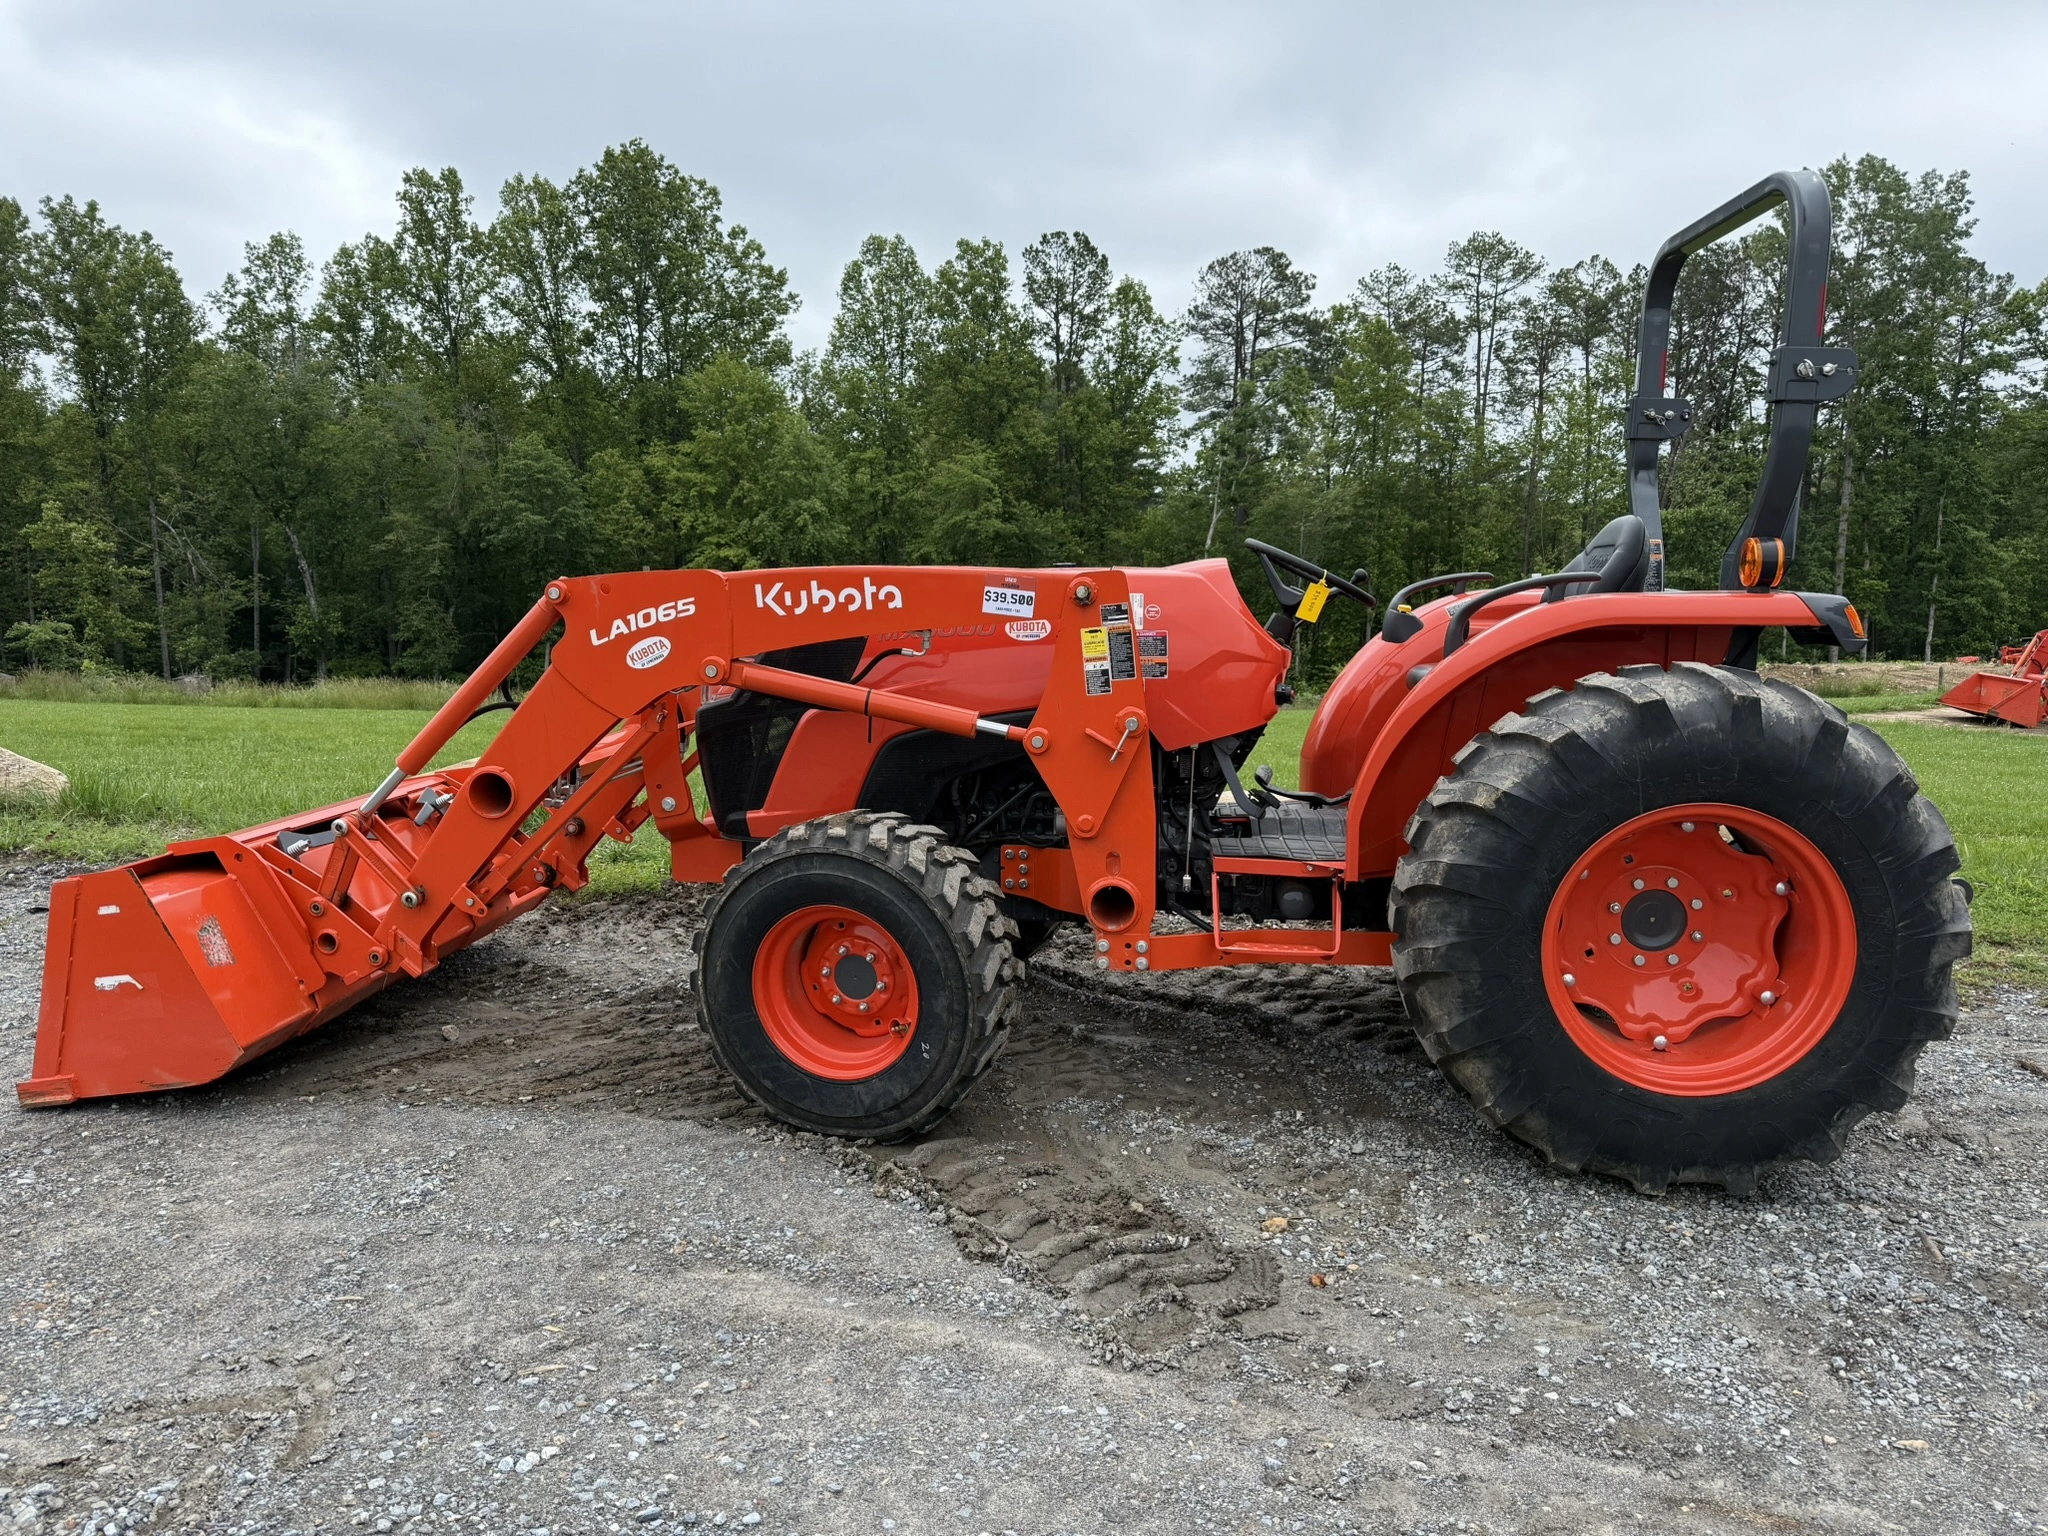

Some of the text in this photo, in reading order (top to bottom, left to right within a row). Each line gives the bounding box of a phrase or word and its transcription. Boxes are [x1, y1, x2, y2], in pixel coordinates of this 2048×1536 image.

[754, 576, 903, 617] Kubota
[589, 596, 696, 646] LA1065
[877, 623, 996, 642] MX000
[1009, 621, 1048, 634] KUBOTA
[628, 639, 669, 666] KUBOTA
